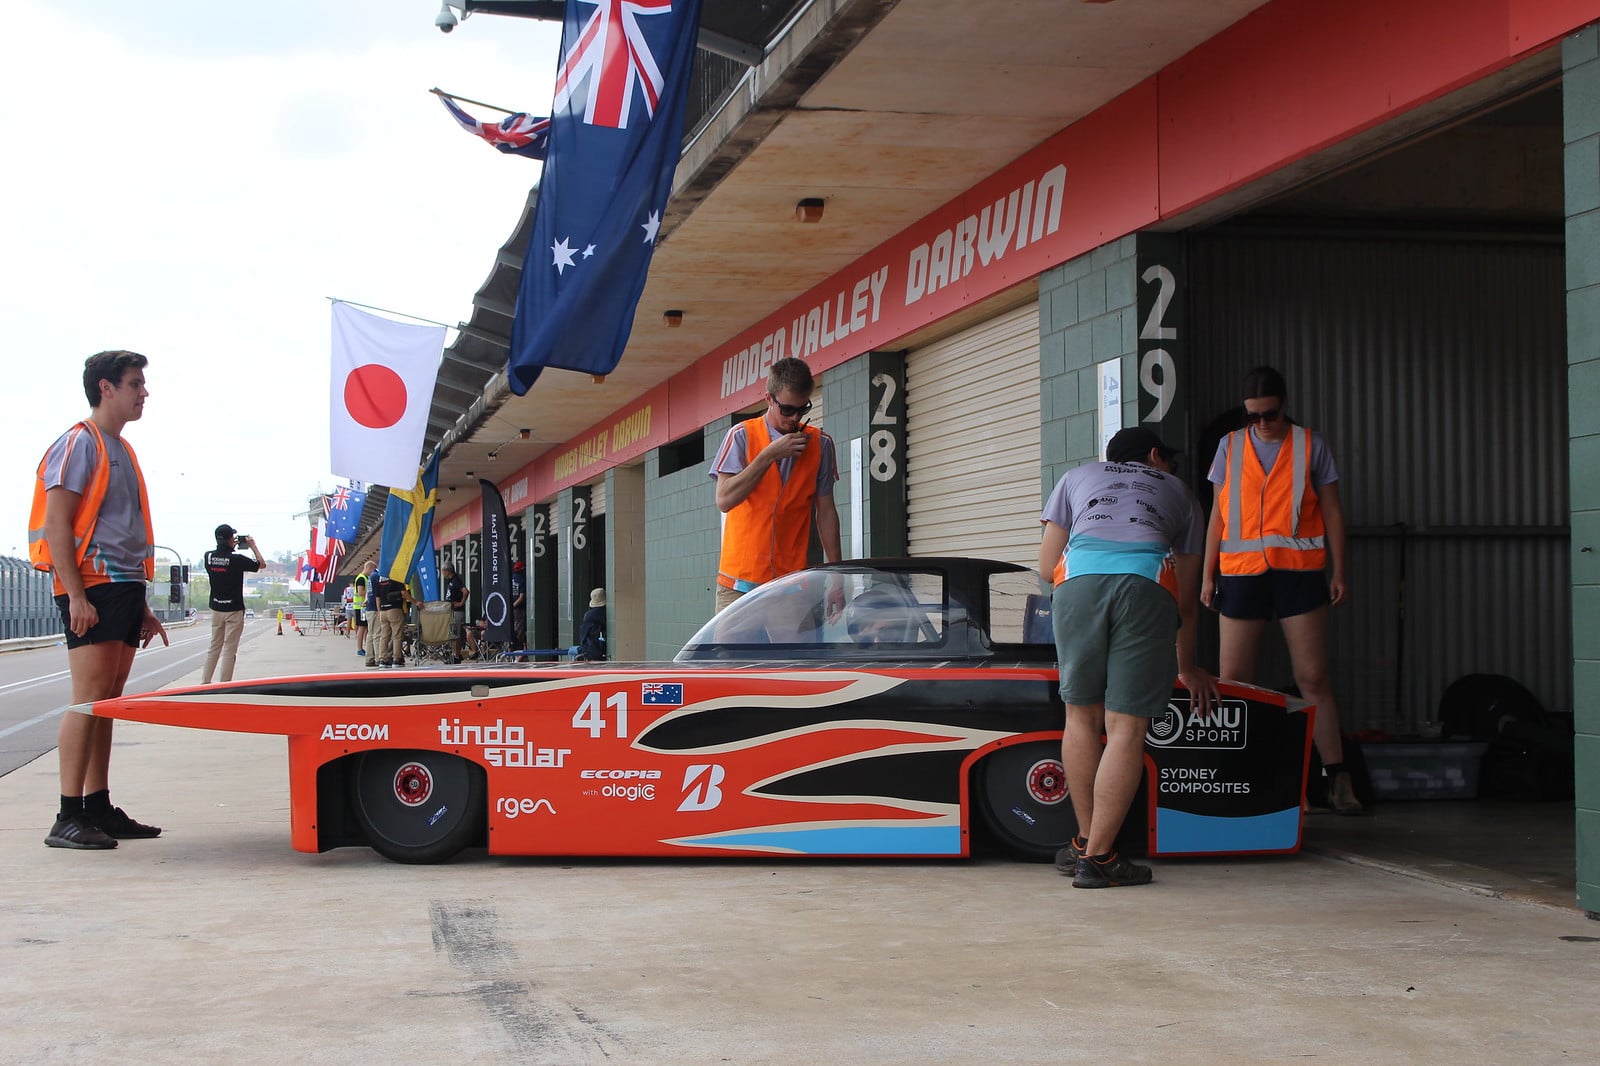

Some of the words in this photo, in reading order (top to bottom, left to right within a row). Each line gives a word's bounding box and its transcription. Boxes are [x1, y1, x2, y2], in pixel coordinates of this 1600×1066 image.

[720, 327, 786, 399] HIDDEN
[791, 265, 889, 358] VALLEY
[905, 163, 1067, 306] DARWIN
[1139, 264, 1177, 422] 29
[579, 429, 608, 469] VALLEY
[612, 405, 651, 453] DARWIN
[869, 373, 897, 482] 28
[534, 512, 546, 557] 25
[573, 498, 587, 550] 26
[470, 540, 478, 573] 22
[572, 691, 628, 738] 41
[1186, 706, 1241, 728] ANU
[320, 724, 389, 741] AECOM
[438, 718, 525, 745] tindo
[1185, 729, 1240, 742] SPORT
[484, 741, 572, 768] solar
[580, 769, 662, 780] ECOPIA
[1160, 768, 1218, 780] SYDNEY
[1160, 782, 1251, 793] COMPOSITES
